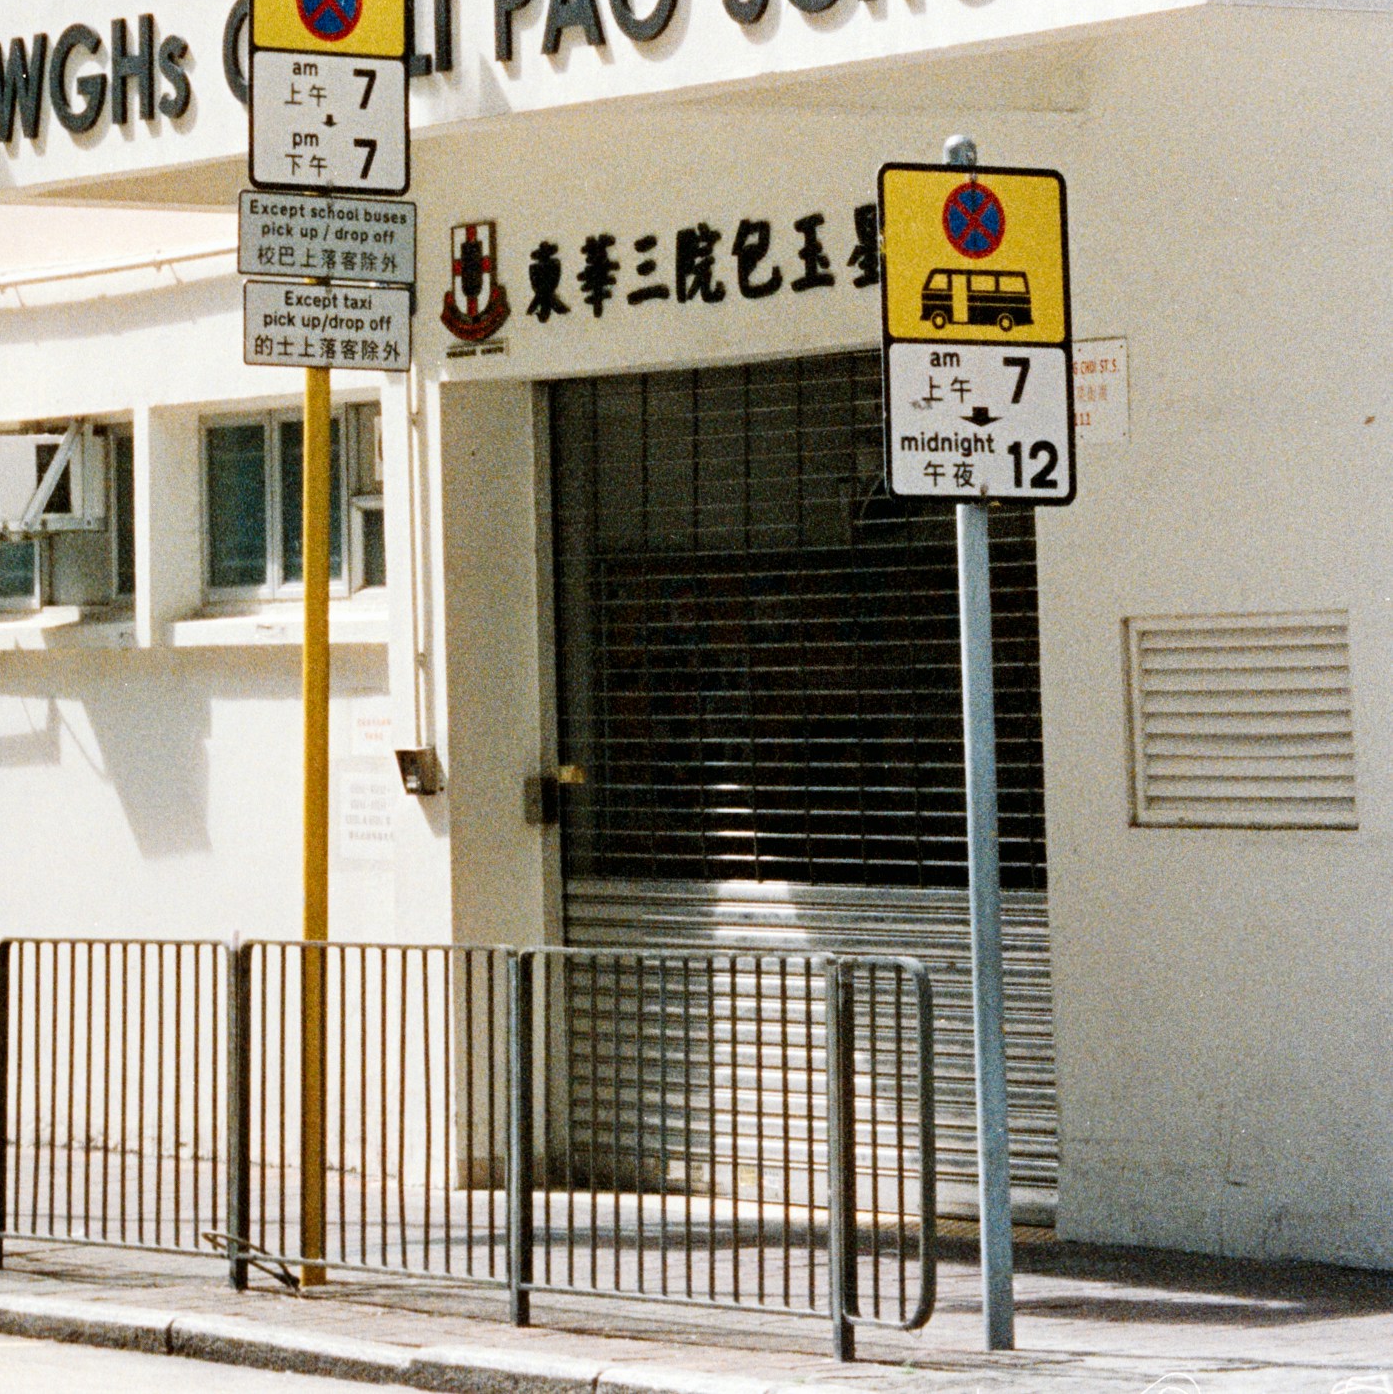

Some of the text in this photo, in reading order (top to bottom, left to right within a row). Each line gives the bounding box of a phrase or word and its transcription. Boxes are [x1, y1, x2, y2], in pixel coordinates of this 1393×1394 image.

[292, 62, 318, 76] am
[285, 83, 327, 107] 上午
[353, 69, 376, 109] 7
[292, 133, 319, 149] pm
[285, 154, 327, 178] 下午
[353, 138, 377, 180] 7
[249, 199, 407, 224] Except school buses
[261, 222, 294, 238] pick
[300, 226, 318, 241] up
[335, 228, 368, 244] drop
[373, 230, 396, 244] off
[257, 245, 398, 274] 校巴上落客除外
[284, 290, 372, 310] Except taxi
[263, 311, 392, 332] pick up/drop off
[254, 334, 401, 362] 的士上落客除外
[930, 351, 960, 367] am
[922, 375, 972, 404] 上午
[1003, 357, 1030, 404] 7
[901, 431, 995, 457] midnight
[923, 460, 975, 487] 午夜
[1008, 440, 1058, 489] 12
